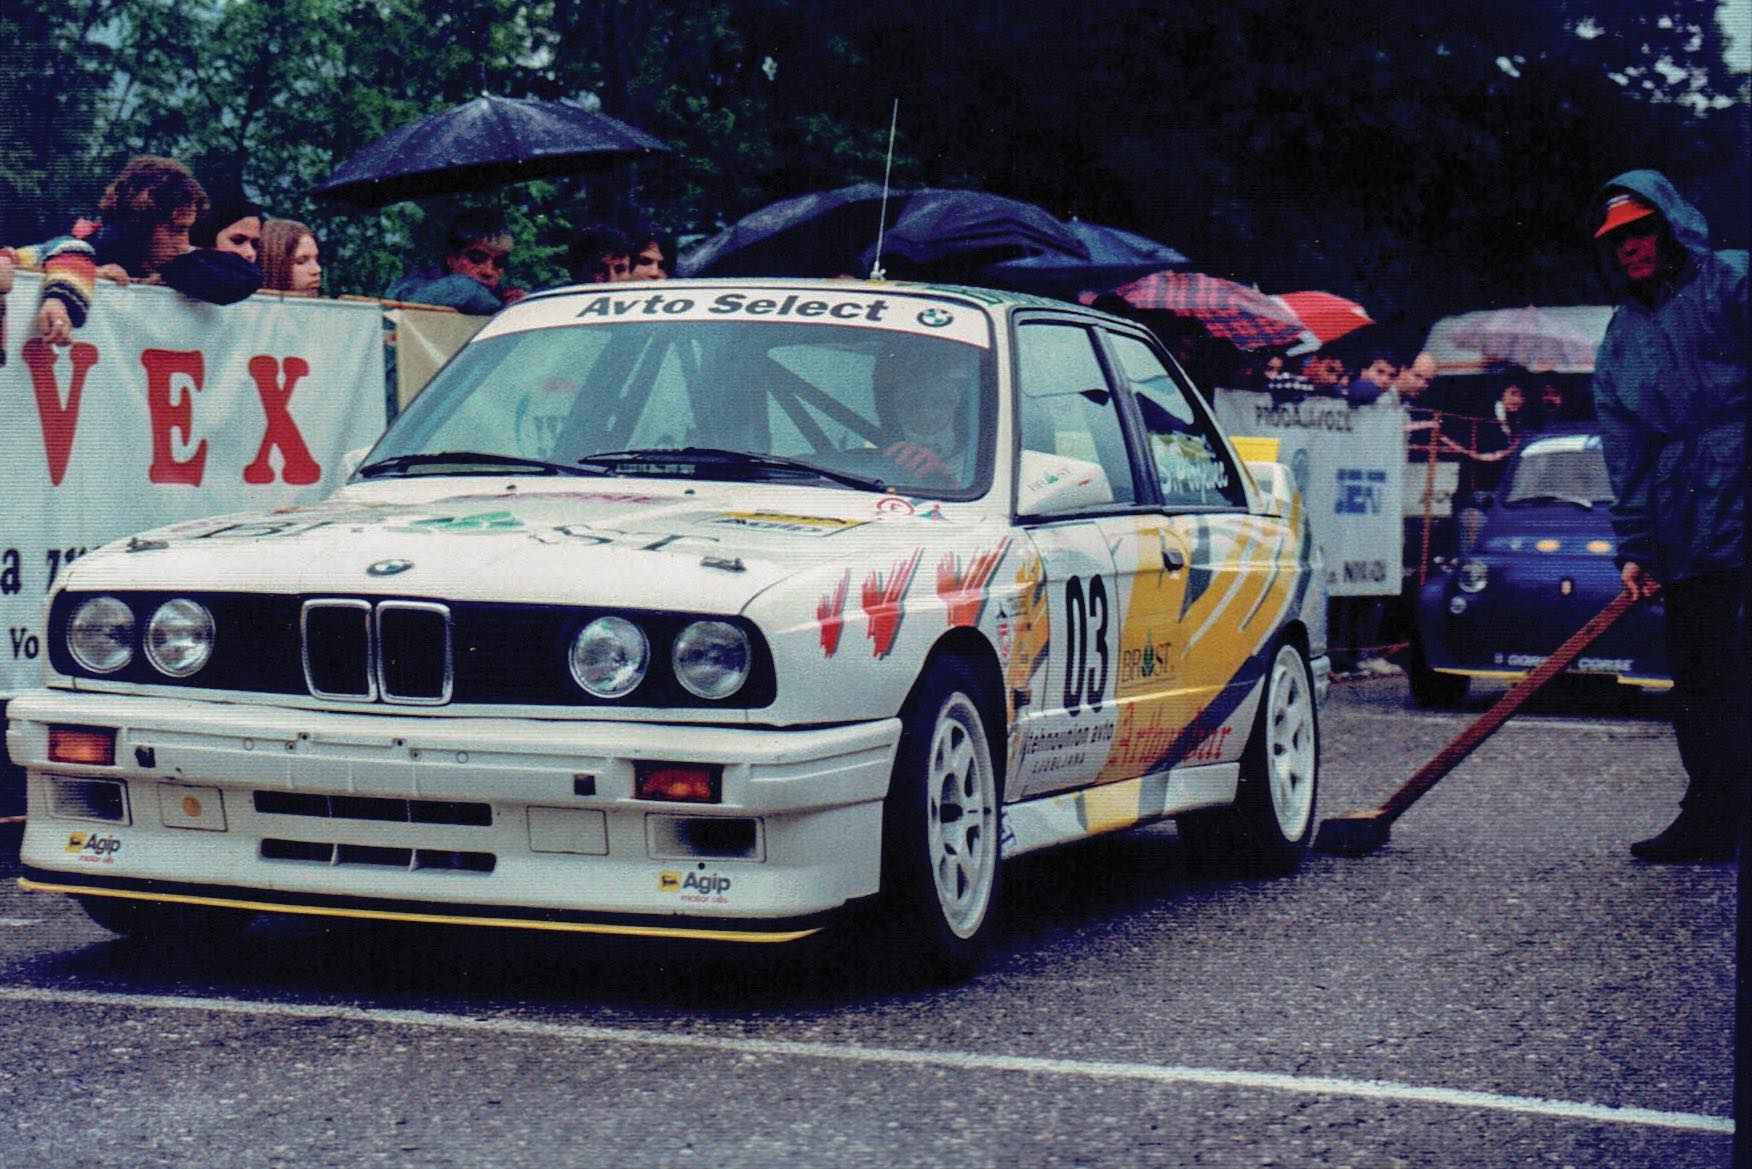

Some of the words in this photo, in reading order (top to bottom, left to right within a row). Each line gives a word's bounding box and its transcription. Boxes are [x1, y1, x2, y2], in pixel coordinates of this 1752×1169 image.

[576, 294, 695, 319] Avto
[708, 293, 889, 322] Select
[1063, 574, 1109, 718] 03
[83, 832, 121, 855] Agip
[682, 871, 732, 895] Agip
